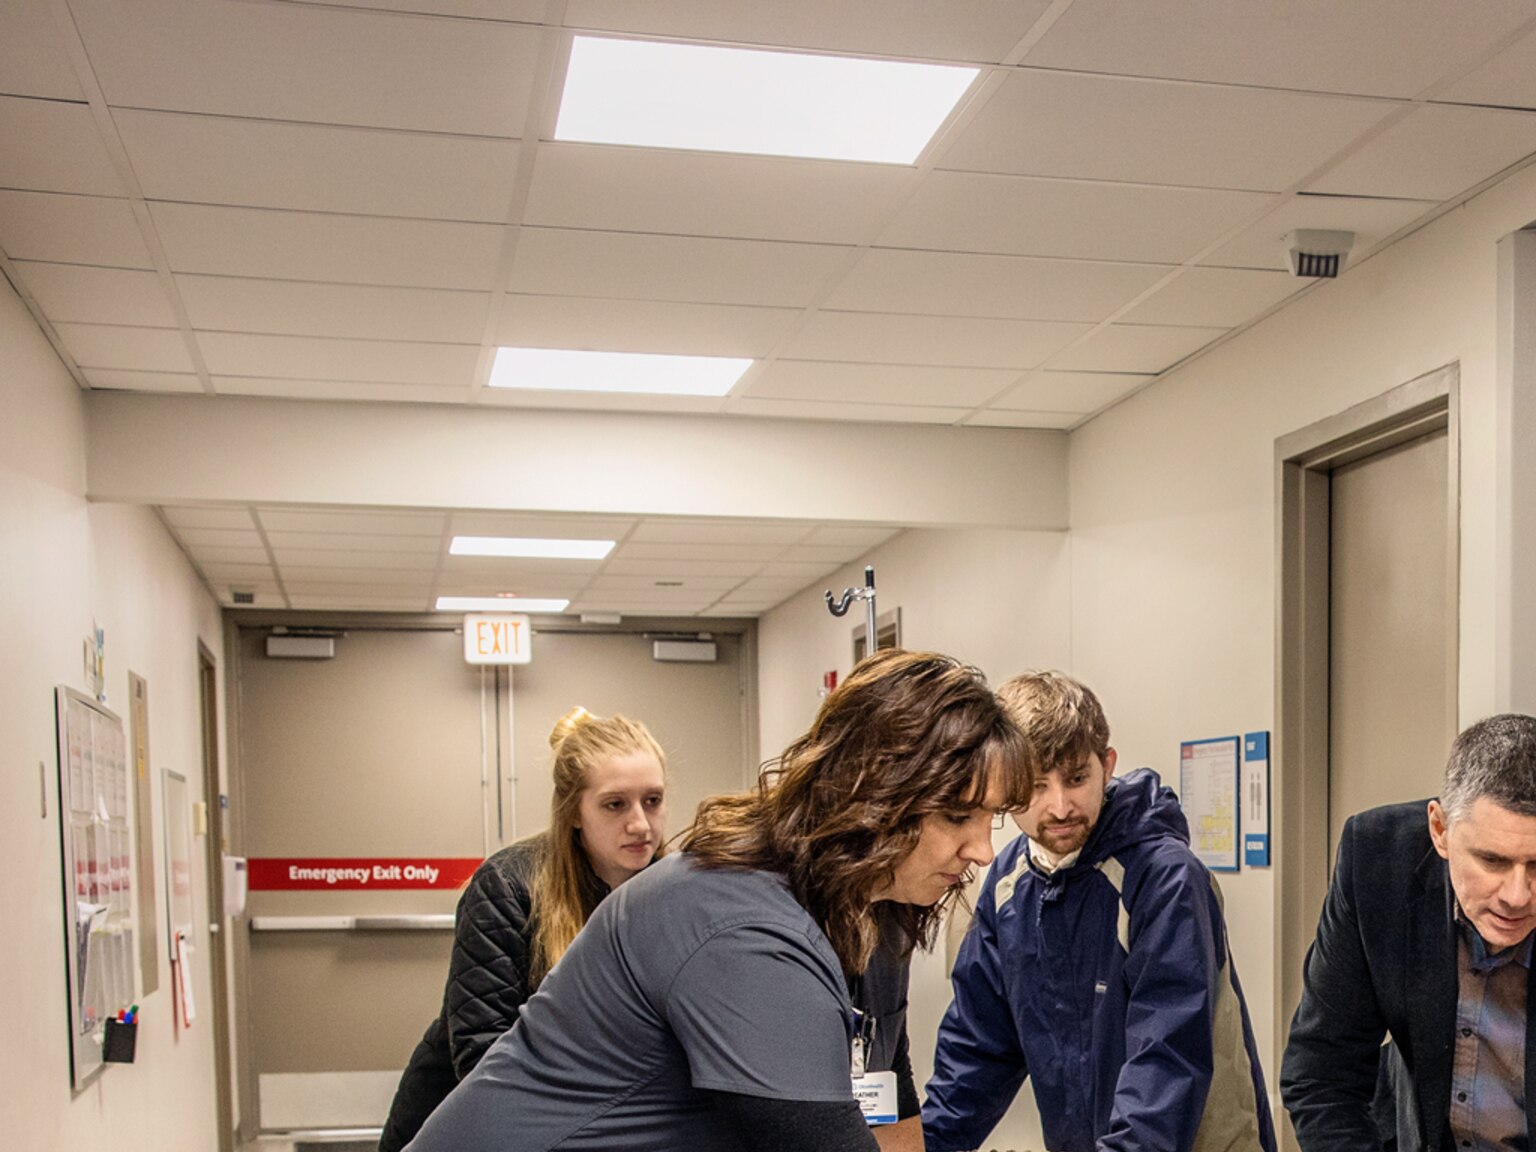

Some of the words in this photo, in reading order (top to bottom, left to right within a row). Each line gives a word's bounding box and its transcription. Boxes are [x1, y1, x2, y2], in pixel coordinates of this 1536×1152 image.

[476, 622, 521, 655] EXIT
[288, 865, 370, 885] Emergency
[372, 865, 402, 880] Exit
[403, 864, 440, 884] Only
